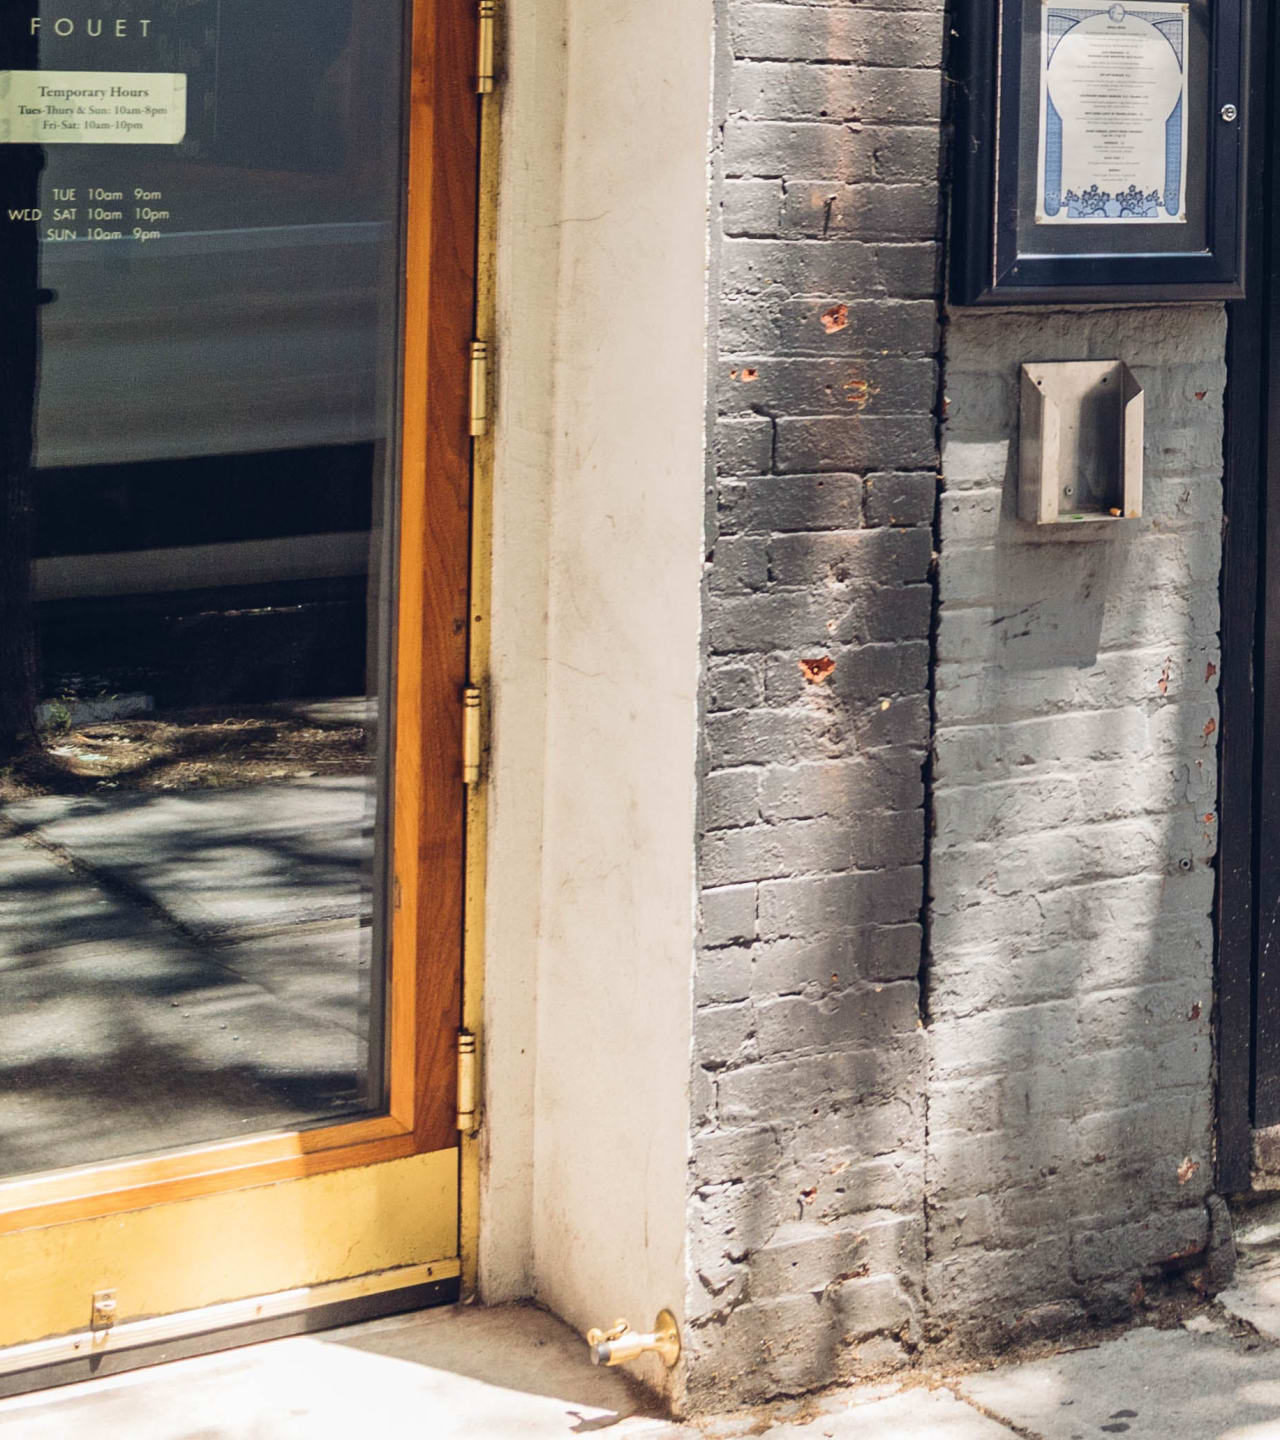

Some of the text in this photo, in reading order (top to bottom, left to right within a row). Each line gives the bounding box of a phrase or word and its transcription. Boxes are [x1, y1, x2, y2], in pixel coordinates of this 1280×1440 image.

[31, 18, 152, 37] FOUET
[38, 86, 149, 100] Temporary Hours
[114, 106, 168, 117] 10am-8pm
[84, 120, 143, 132] 10am-10pm
[53, 188, 77, 201] TUE
[88, 188, 123, 201] 10am
[53, 209, 77, 221] SAT
[88, 208, 122, 221] 10am
[136, 208, 169, 222] 10pm
[47, 227, 160, 242] SUN 10am 9pm
